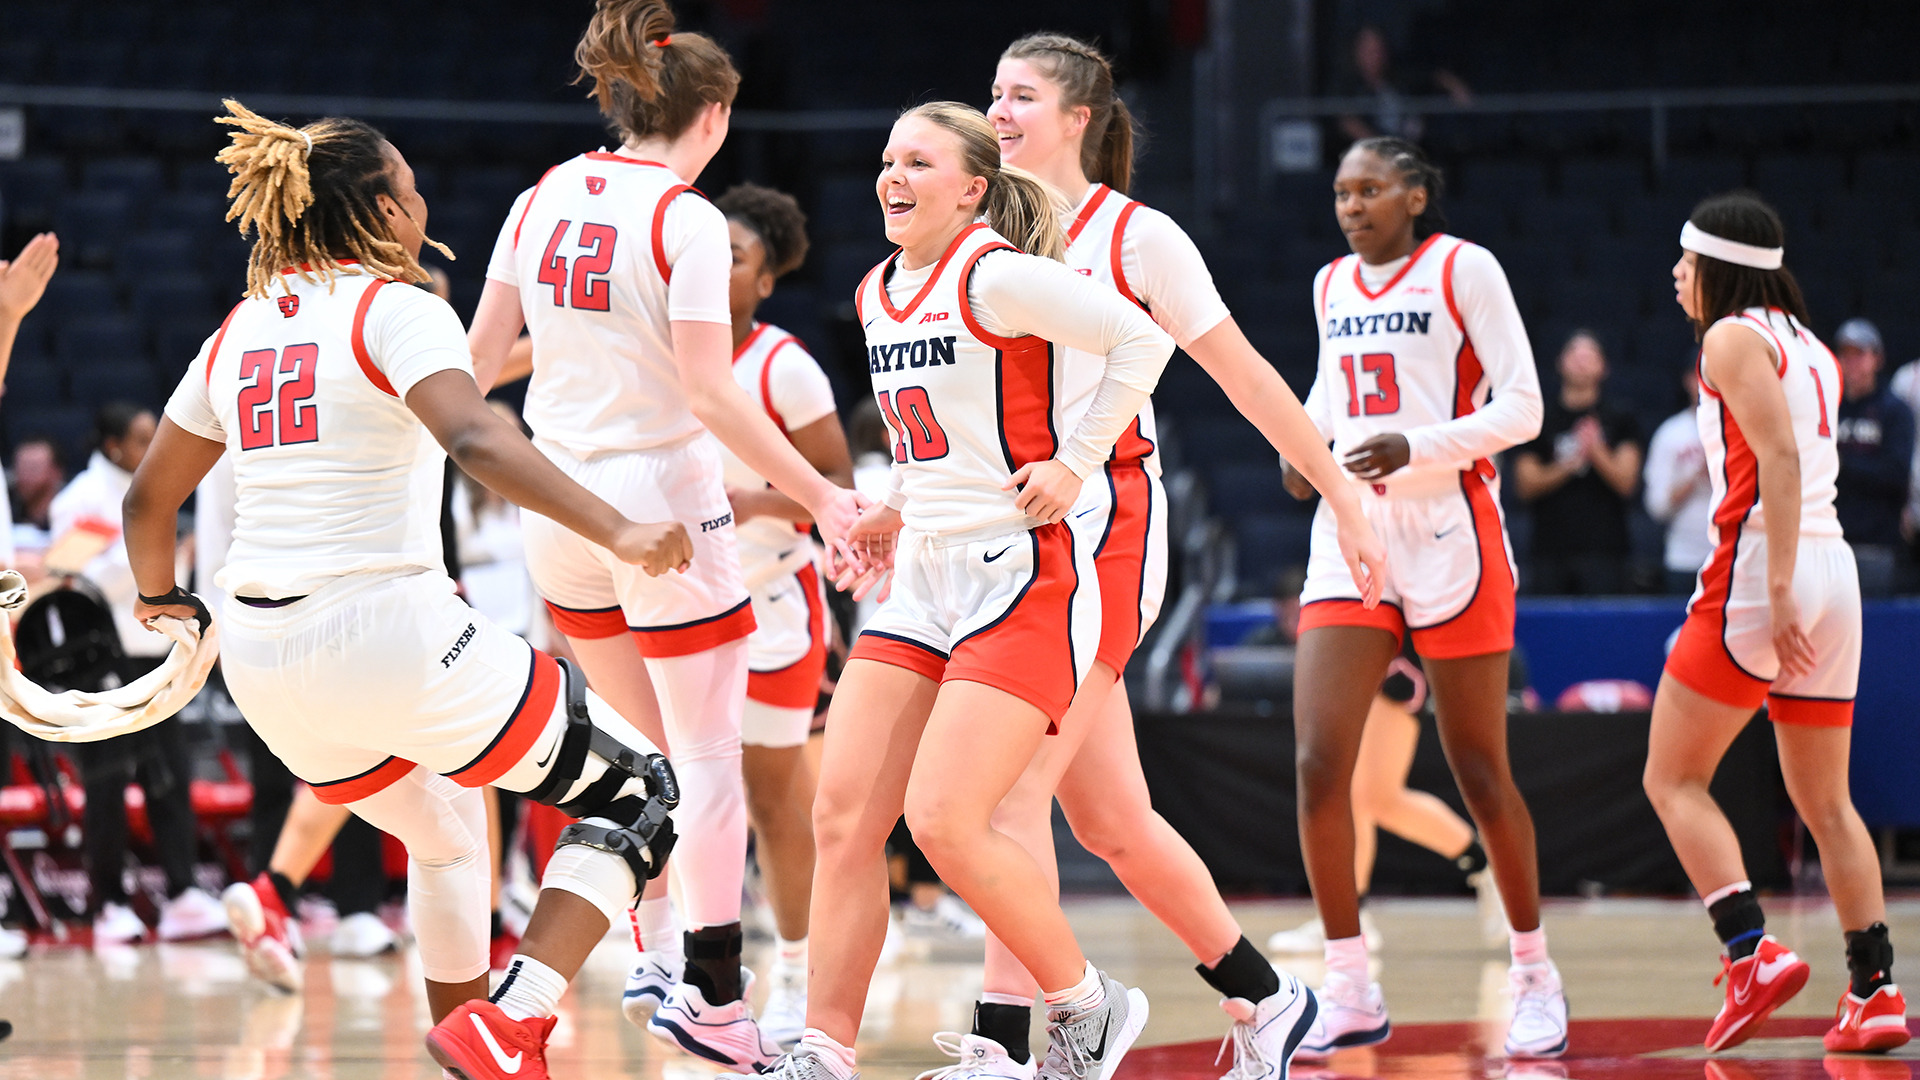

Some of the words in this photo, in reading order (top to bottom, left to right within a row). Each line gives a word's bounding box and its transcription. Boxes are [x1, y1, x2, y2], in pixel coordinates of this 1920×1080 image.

[537, 219, 618, 312] 42
[868, 335, 957, 374] AYTON
[1327, 312, 1432, 338] DAYTON
[237, 342, 319, 451] 22
[1340, 353, 1400, 417] 13
[1808, 366, 1831, 439] 1
[878, 386, 949, 464] 10
[441, 622, 477, 669] FLYERS
